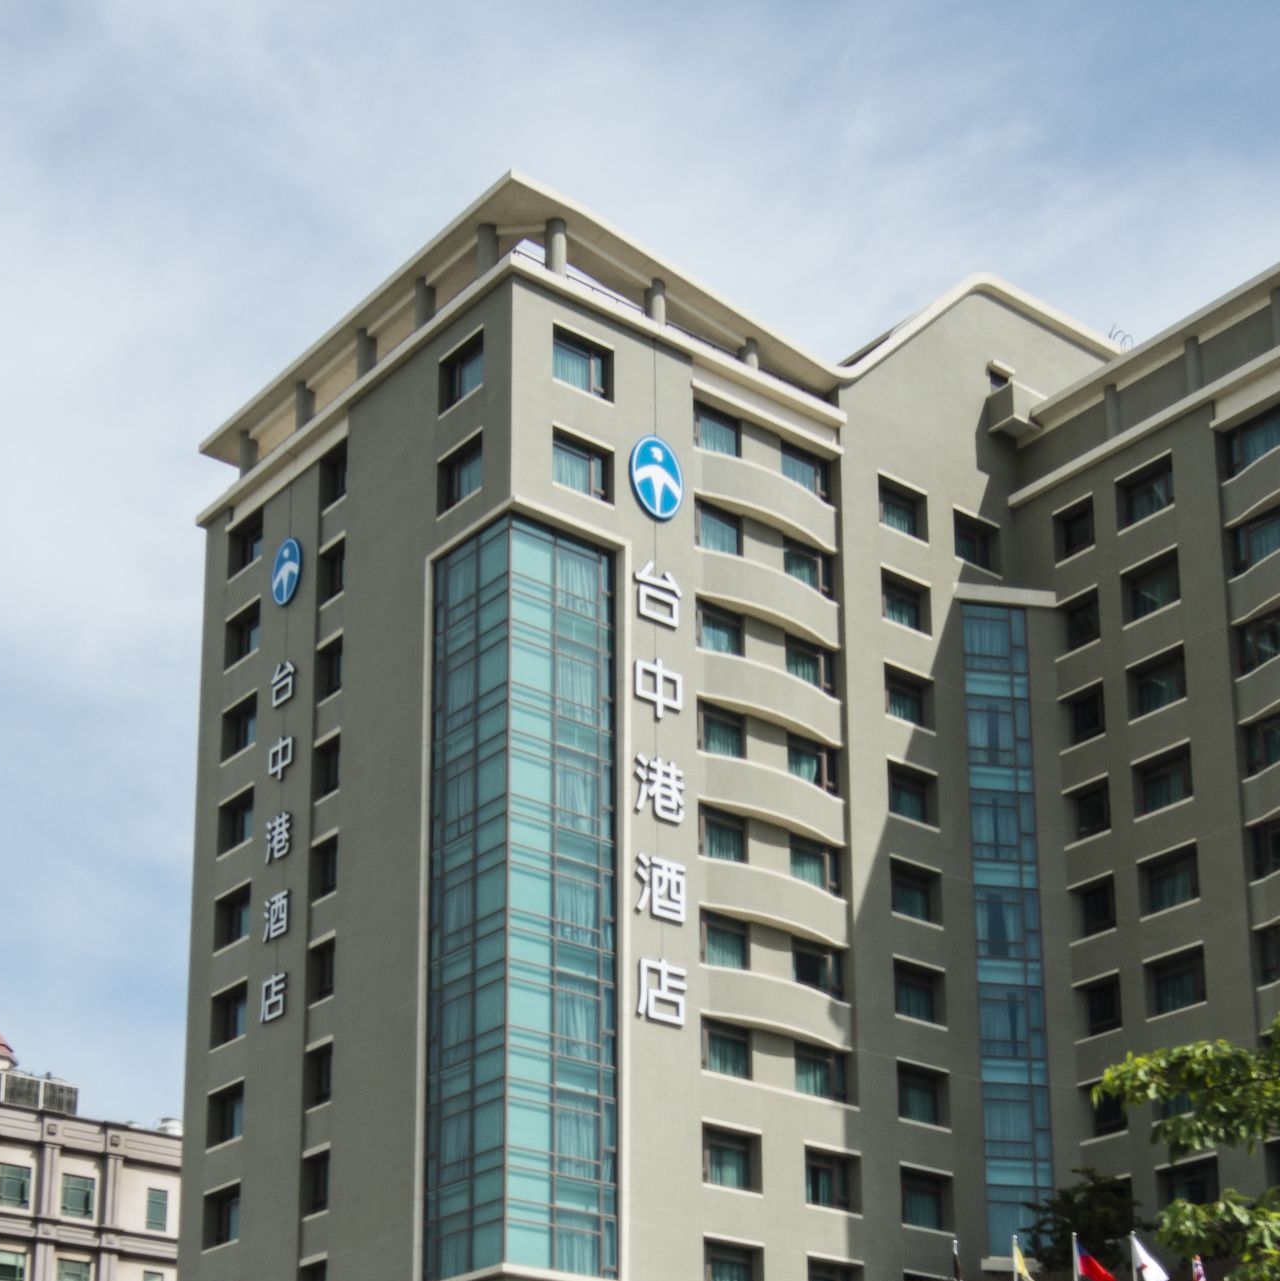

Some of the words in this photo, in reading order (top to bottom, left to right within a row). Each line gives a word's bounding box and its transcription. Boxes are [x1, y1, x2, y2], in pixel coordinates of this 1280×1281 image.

[260, 659, 297, 1024] 台中港酒店
[634, 559, 688, 1028] 台中港酒店
